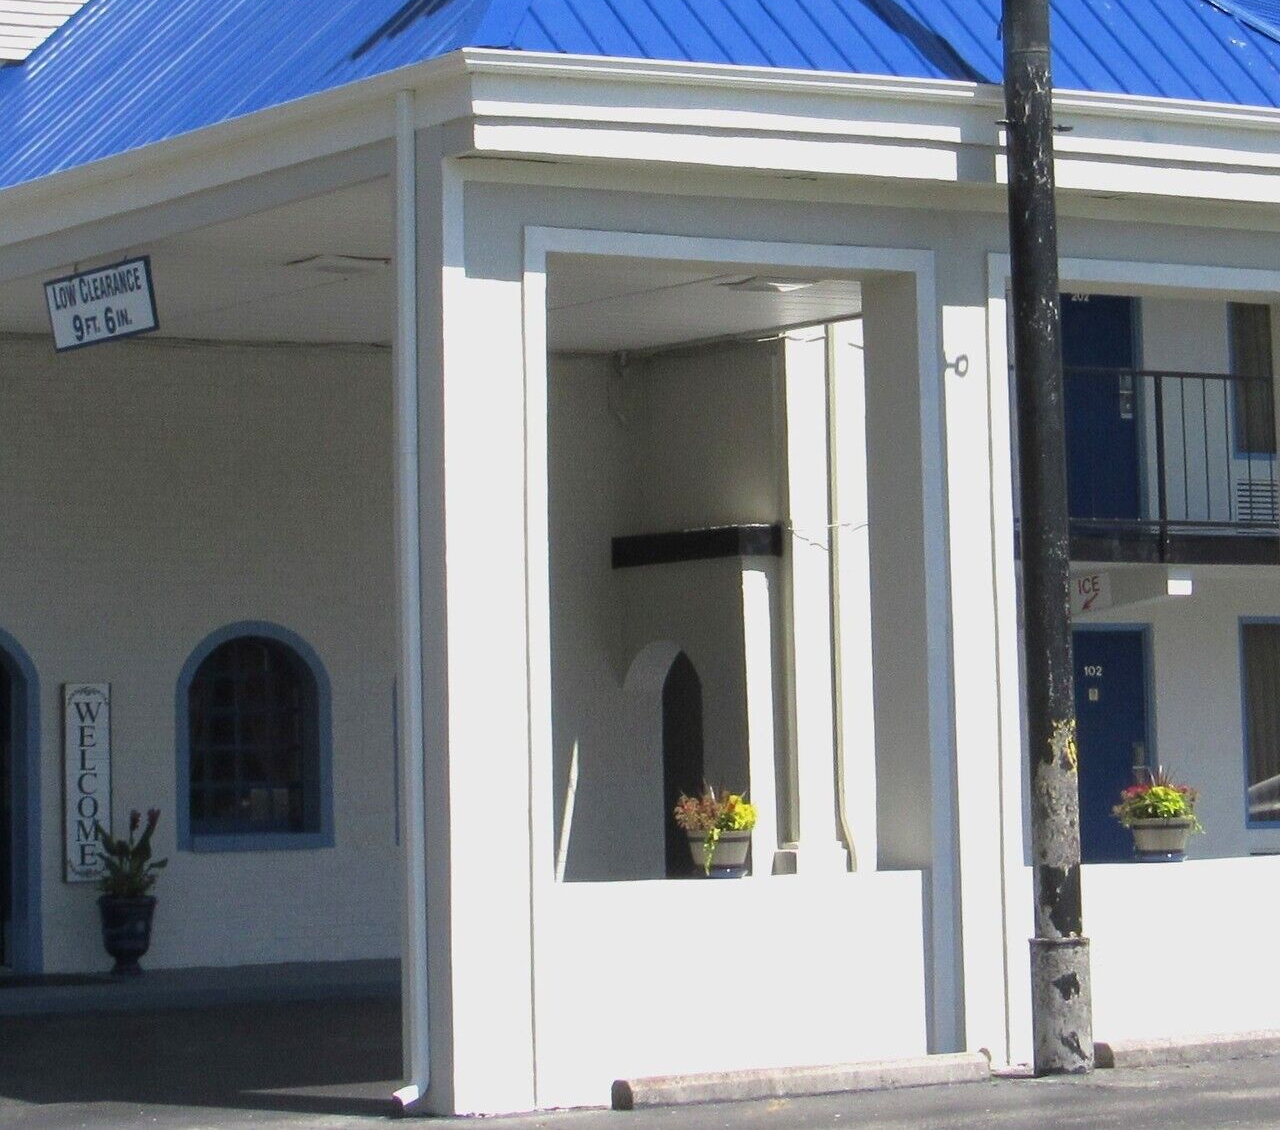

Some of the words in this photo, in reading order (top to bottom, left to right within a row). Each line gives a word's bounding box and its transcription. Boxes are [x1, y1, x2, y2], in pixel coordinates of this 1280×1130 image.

[52, 283, 77, 311] LOW
[78, 267, 142, 304] CLEARANCE
[1078, 575, 1101, 595] ICE
[1083, 665, 1103, 677] 102
[74, 701, 102, 867] WELCOME
